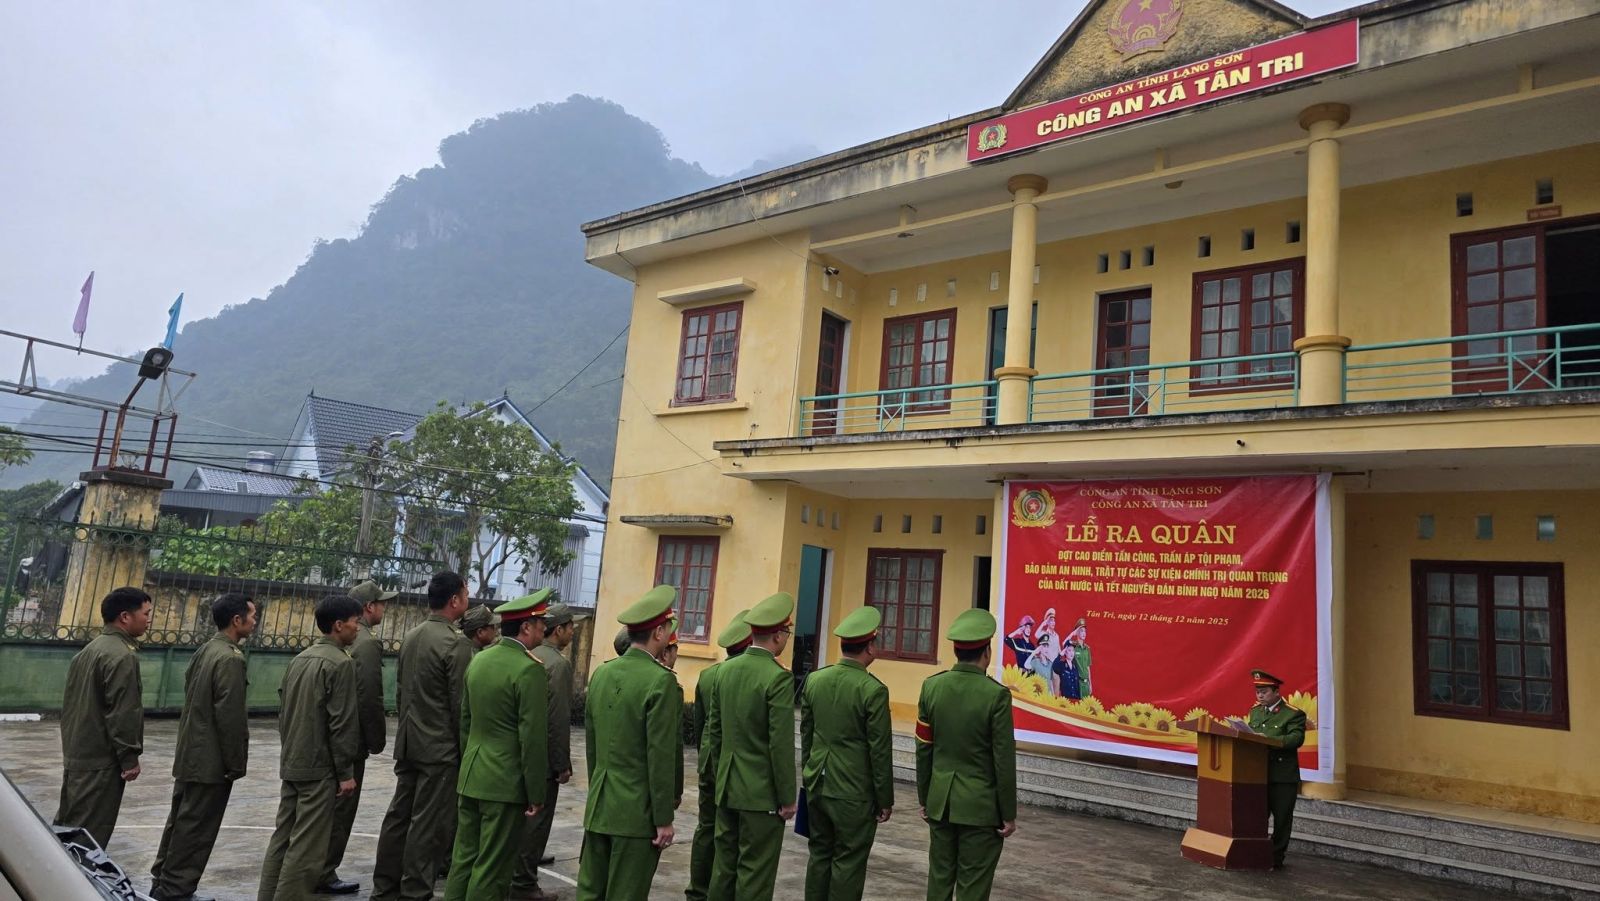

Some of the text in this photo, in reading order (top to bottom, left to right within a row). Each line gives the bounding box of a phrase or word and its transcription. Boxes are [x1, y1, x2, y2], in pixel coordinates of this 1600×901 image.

[1080, 53, 1243, 104] CÔNG AN TỈNH LẠNG SƠN
[1037, 52, 1304, 136] CÔNG AN XÃ TÂN TRI
[1112, 488, 1128, 496] AN
[1124, 501, 1140, 509] AN
[1188, 500, 1208, 508] TRI
[1065, 516, 1237, 545] LỄ RA QUÂN
[1058, 548, 1243, 567] ĐỢT CAO ĐIỂM TẤN CÔNG, TRẤN ÁP TỘI PHẠM,
[1025, 562, 1039, 574] BẢO
[1059, 566, 1069, 575] AN
[1072, 566, 1093, 577] NINH,
[1096, 566, 1115, 579] TRẬT
[1117, 567, 1128, 581] TỰ
[1129, 566, 1146, 578] CÁC
[1148, 568, 1160, 581] SỰ
[1161, 567, 1181, 581] KIỆN
[1183, 568, 1210, 580] CHÍNH
[1213, 570, 1227, 583] TRỊ
[1229, 571, 1254, 583] QUAN
[1257, 571, 1288, 585] TRỌNG
[1039, 577, 1053, 589] CỦA
[1071, 580, 1092, 591] NƯỚC
[1094, 580, 1104, 592] VÀ
[1106, 579, 1120, 593] TẾT
[1122, 582, 1155, 594] NGUYÊN
[1177, 584, 1198, 596] BÍNH
[1201, 587, 1218, 599] NGỌ
[1221, 585, 1243, 598] NĂM
[1246, 588, 1269, 599] 2026
[1139, 613, 1149, 621] 12
[1175, 615, 1185, 623] 12
[1187, 616, 1205, 624] năm
[1208, 617, 1229, 625] 2025
